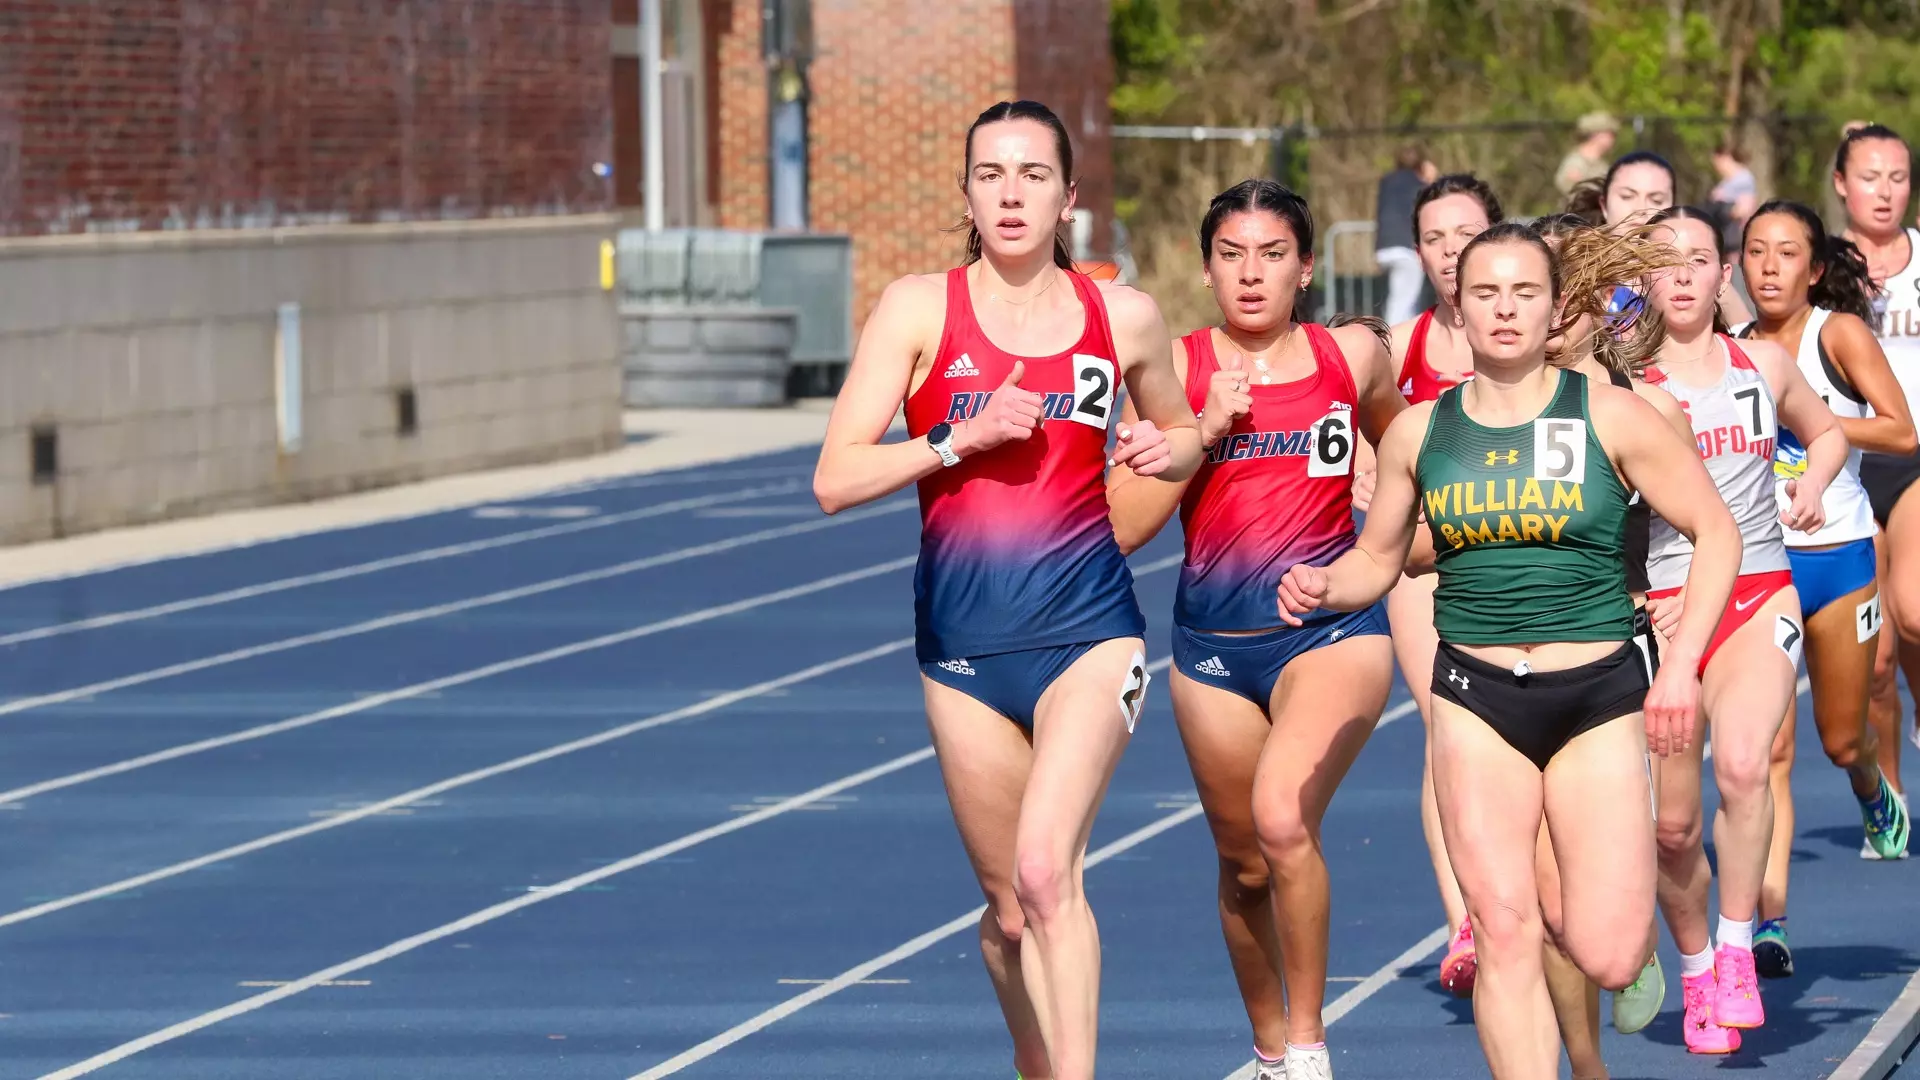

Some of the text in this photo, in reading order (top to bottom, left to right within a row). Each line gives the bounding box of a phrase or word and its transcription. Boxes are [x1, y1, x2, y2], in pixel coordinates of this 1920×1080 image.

[944, 368, 979, 378] adidas
[1077, 367, 1108, 418] 2
[1734, 387, 1762, 436] 7
[1207, 430, 1312, 463] ICHMO
[1318, 418, 1349, 465] 6
[1546, 422, 1574, 478] 5
[1426, 477, 1584, 521] WILLIAM
[1780, 616, 1800, 652] 7
[938, 660, 975, 676] adidas
[1195, 663, 1230, 677] adidas
[1122, 665, 1143, 720] 2
